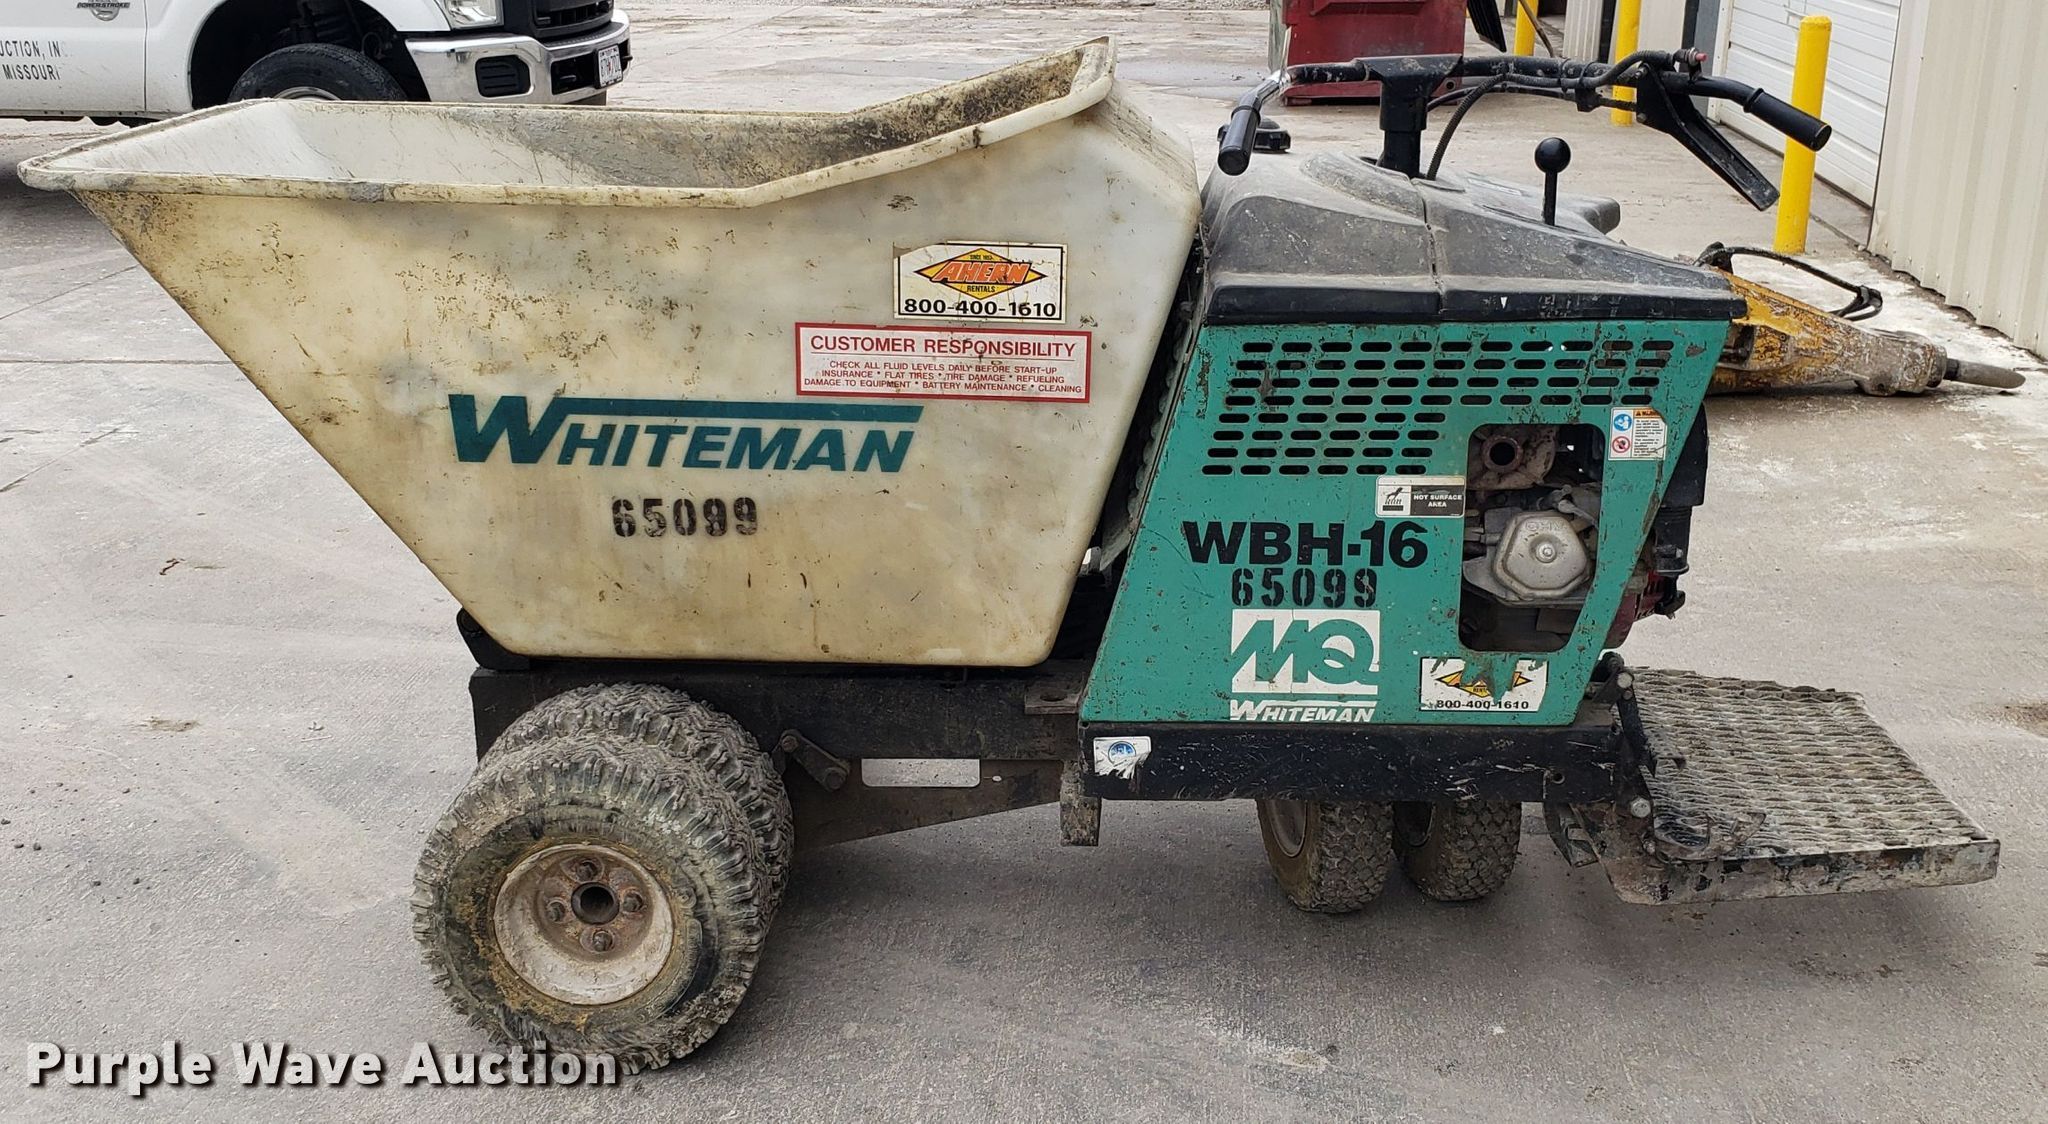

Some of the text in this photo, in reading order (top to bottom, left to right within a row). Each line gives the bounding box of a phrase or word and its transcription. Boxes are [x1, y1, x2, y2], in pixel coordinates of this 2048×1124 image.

[2, 64, 61, 80] MISSOURI
[931, 261, 1030, 284] AHERN
[966, 285, 996, 293] RENTALS
[904, 298, 1057, 317] 800-400-1610
[811, 335, 1076, 357] CUSTOMER RESPONSIBILITY
[822, 369, 1065, 384] INSURANCE FLAT TIRES TIRE DAMAGE REFUELING
[830, 360, 1058, 375] CHECK ALL FLUID LEVELS DAILY BEFORE START-UP
[804, 378, 1083, 393] DAMAGE TO EQUIPMENT BATTERY MAINTENANCE CLEANING
[448, 394, 924, 473] WHITEMAN
[1183, 520, 1429, 568] WBH-16
[1231, 568, 1378, 608] 65099
[1231, 618, 1379, 685] MQ
[1230, 700, 1378, 722] WHITEMAN
